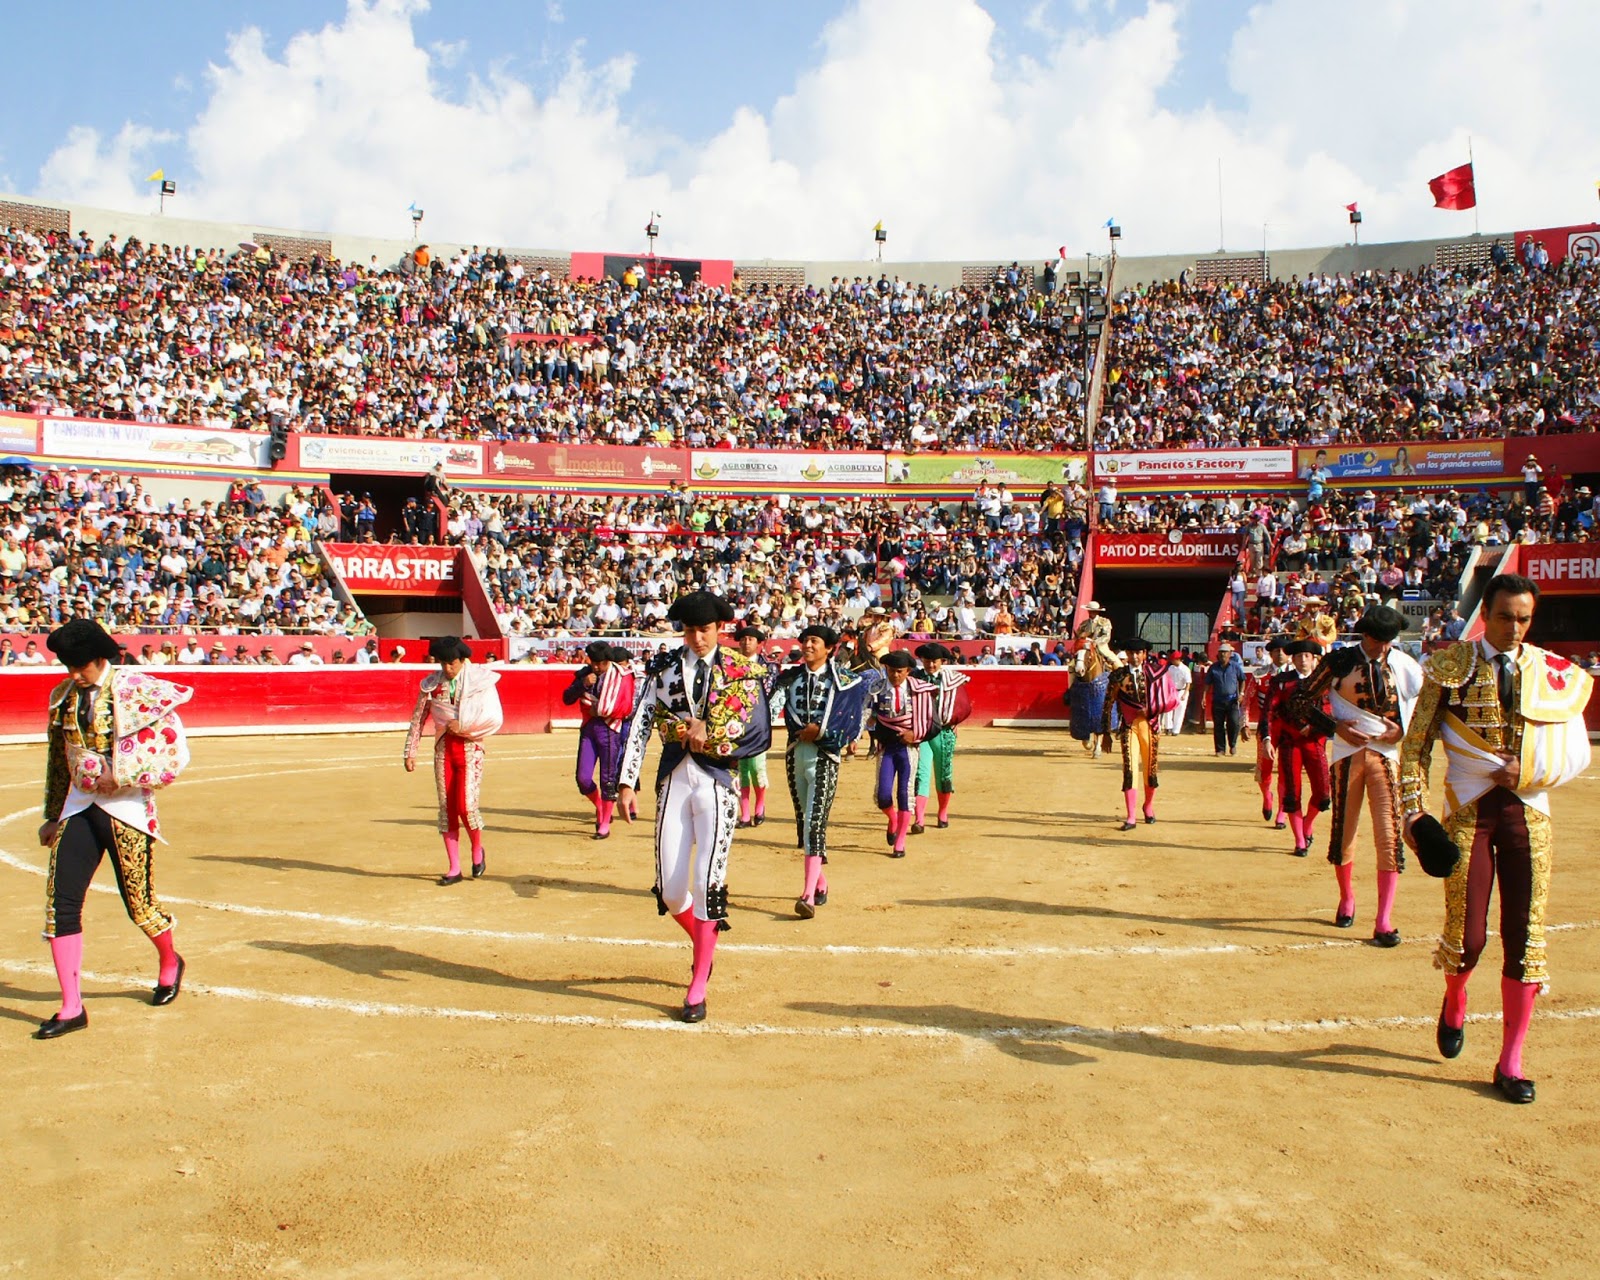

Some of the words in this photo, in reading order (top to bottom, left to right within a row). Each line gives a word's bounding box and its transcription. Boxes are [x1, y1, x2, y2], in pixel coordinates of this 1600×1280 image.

[1427, 451, 1458, 460] Siempre
[1458, 450, 1491, 459] presente
[568, 457, 624, 470] moskato
[1195, 459, 1247, 470] Factory
[1427, 461, 1438, 469] los
[1440, 460, 1471, 470] grandes
[1472, 459, 1502, 467] eventos
[1100, 544, 1136, 557] PATIO
[1139, 544, 1156, 557] DE
[1158, 543, 1239, 557] CUADRILLAS
[333, 556, 454, 580] ARRASTRE
